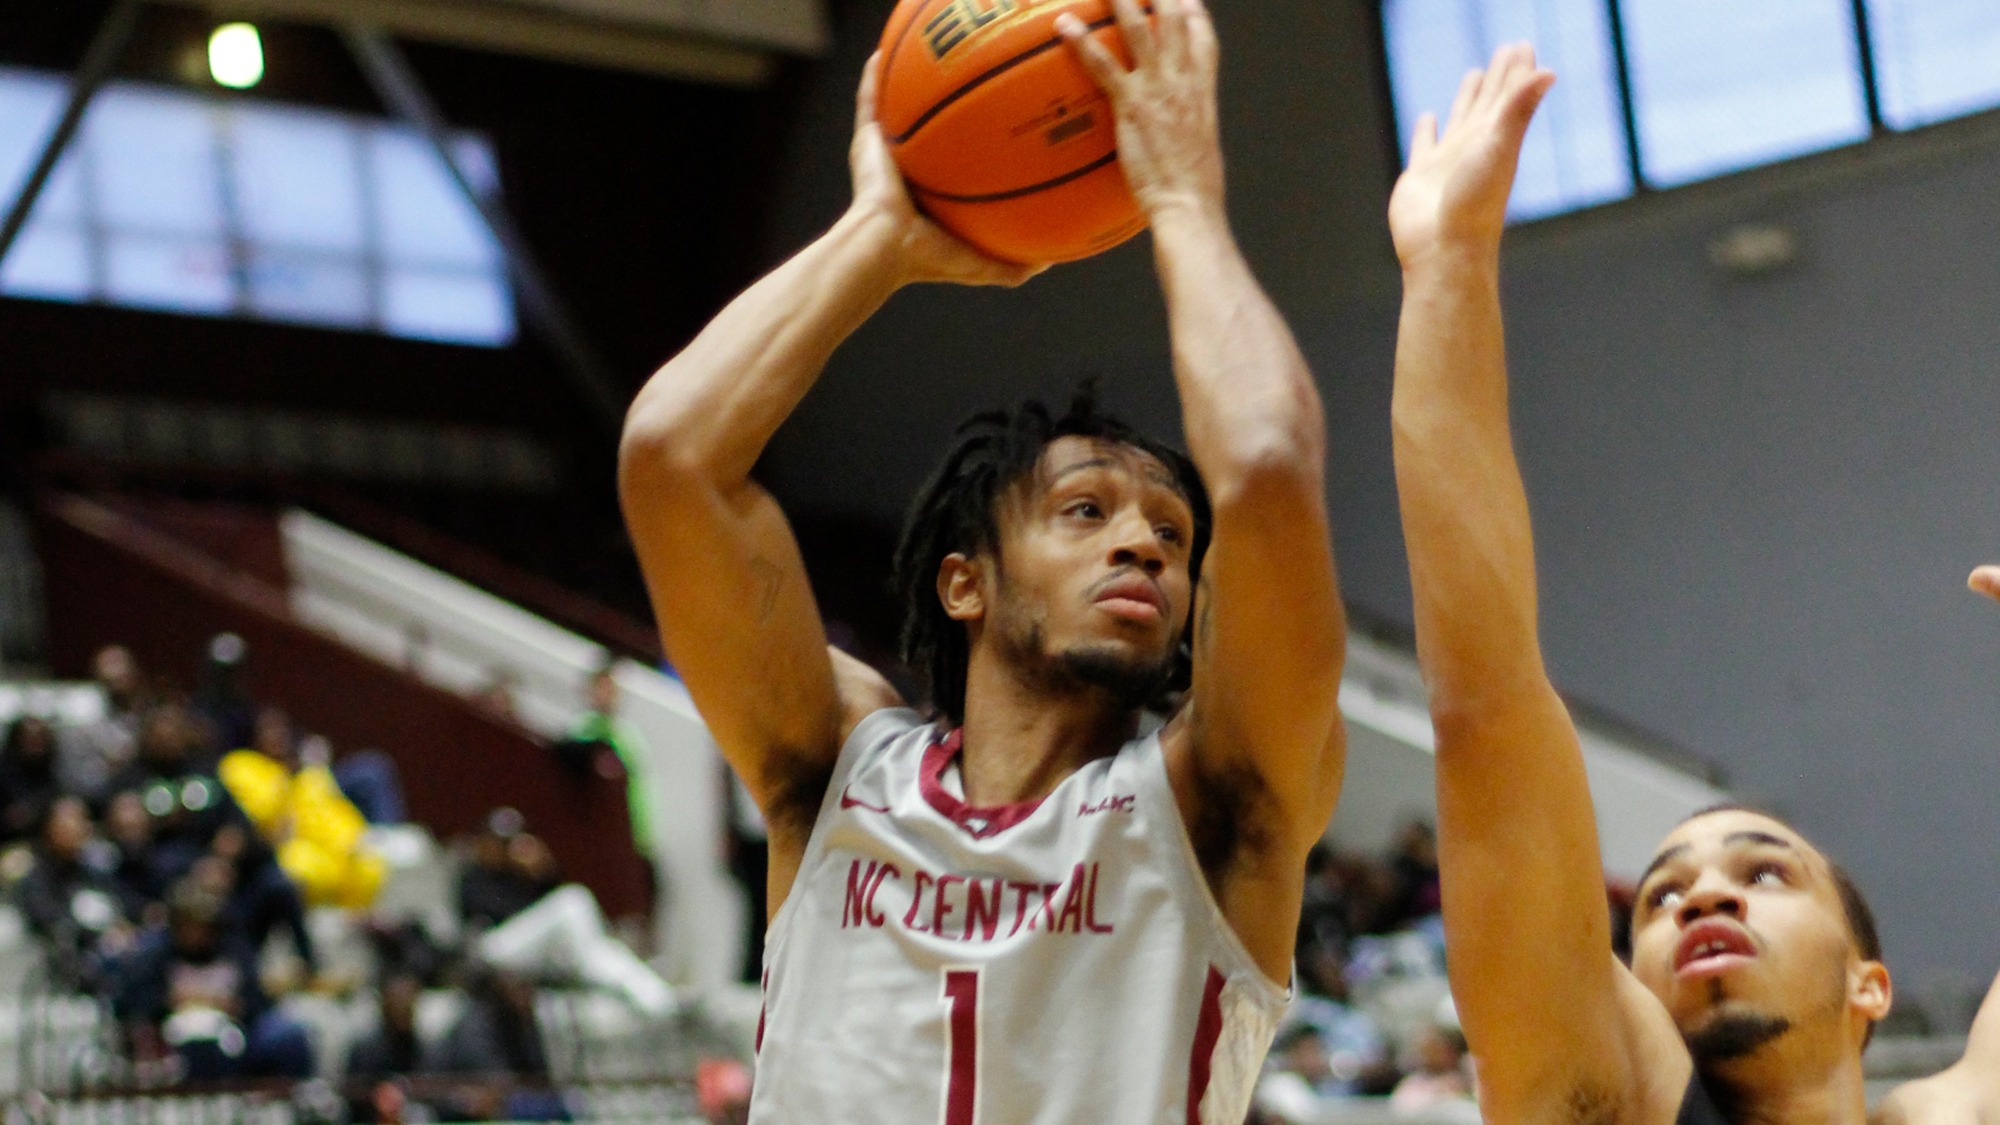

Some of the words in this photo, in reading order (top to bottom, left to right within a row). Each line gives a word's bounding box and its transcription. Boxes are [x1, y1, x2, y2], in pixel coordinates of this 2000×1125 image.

[841, 859, 900, 929] NC
[903, 861, 1113, 942] CENTRAL
[942, 967, 981, 1125] 1
